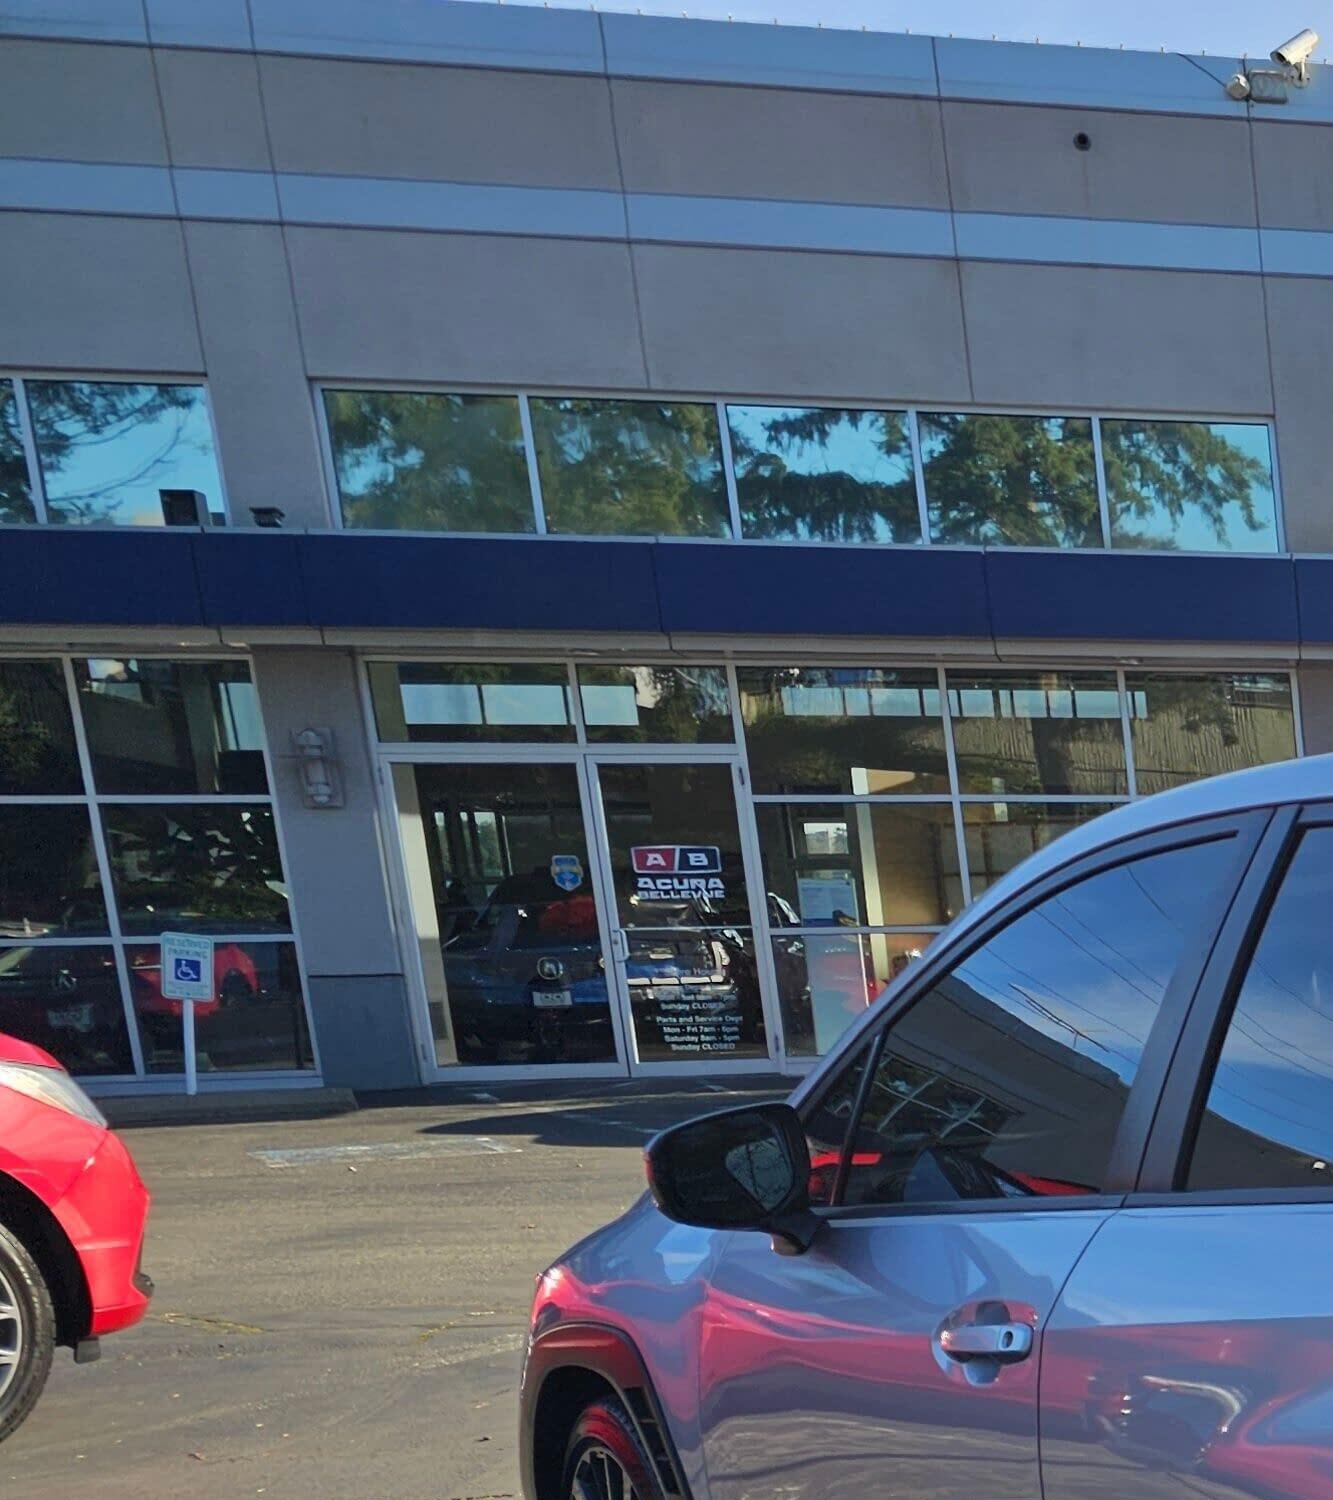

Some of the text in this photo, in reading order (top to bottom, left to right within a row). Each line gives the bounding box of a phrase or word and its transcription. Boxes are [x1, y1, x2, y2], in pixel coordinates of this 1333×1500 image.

[646, 853, 709, 866] A B
[637, 877, 725, 890] ACURA
[637, 890, 725, 900] BELLEVUE
[664, 1035, 699, 1043] Saturday
[671, 1043, 735, 1053] Sunday CLOSED
